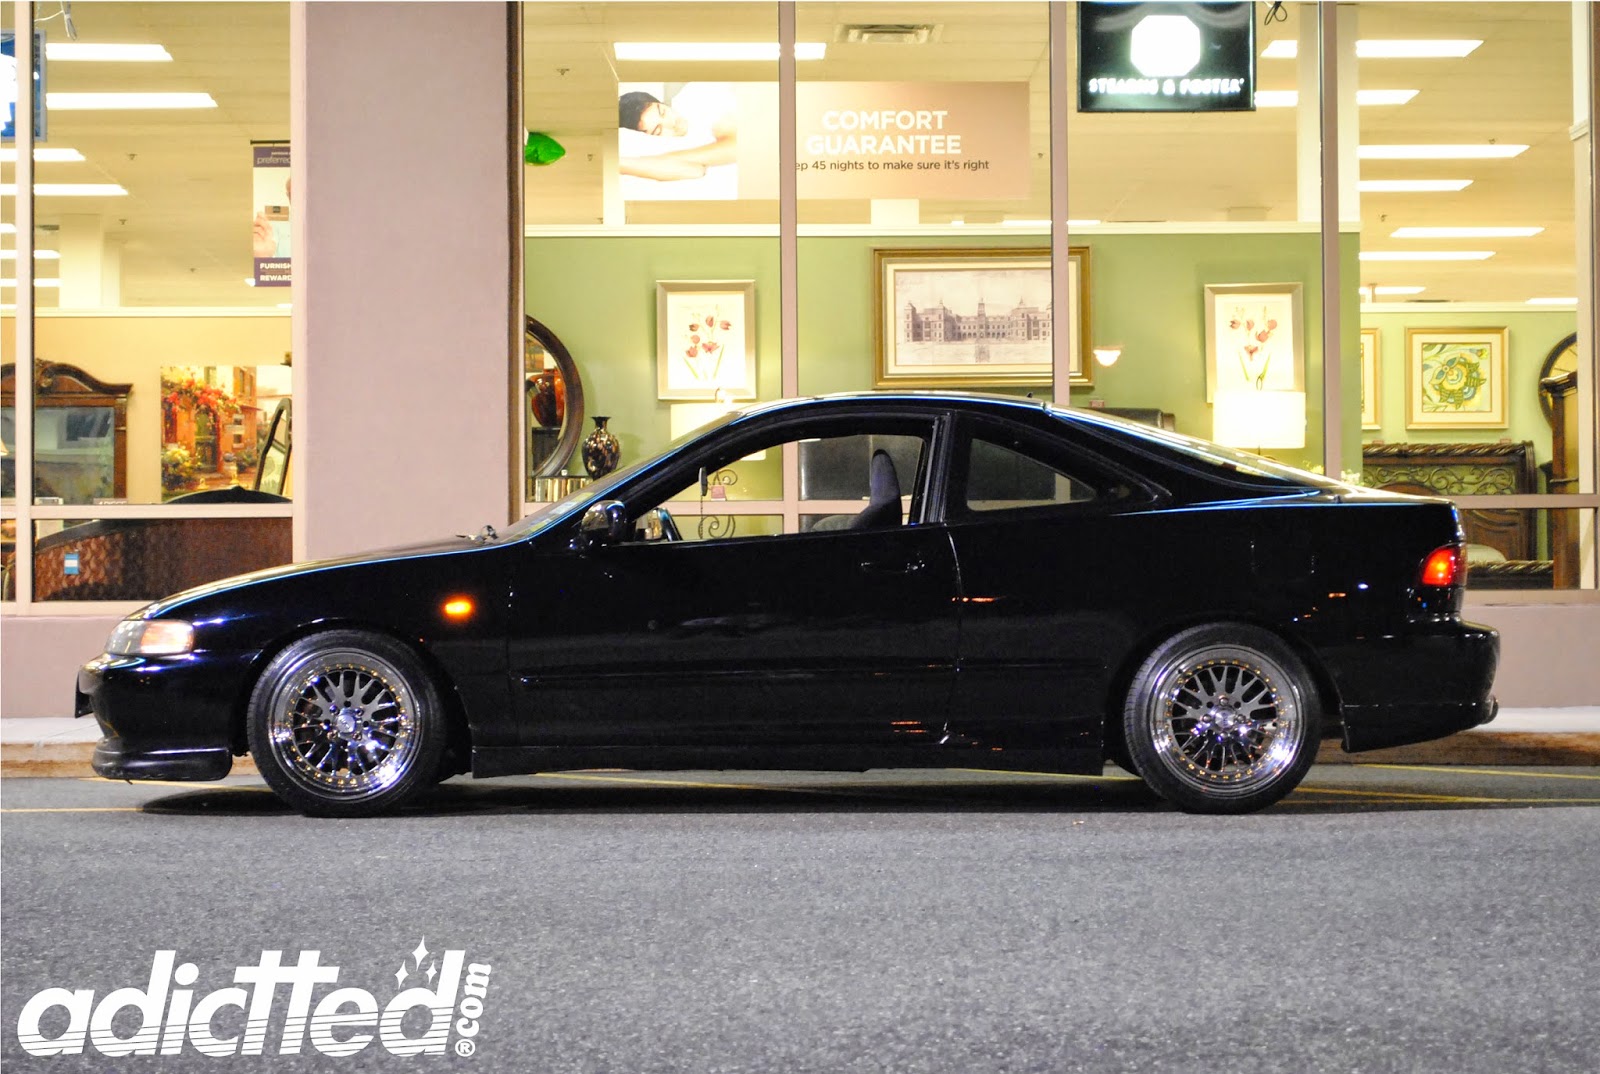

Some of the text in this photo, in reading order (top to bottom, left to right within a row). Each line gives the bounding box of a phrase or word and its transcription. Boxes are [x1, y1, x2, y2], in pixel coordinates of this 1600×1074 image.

[821, 110, 948, 131] COMFORT
[805, 135, 961, 155] GUARANTEE
[796, 160, 989, 171] ep 45 nights to make sure it's right
